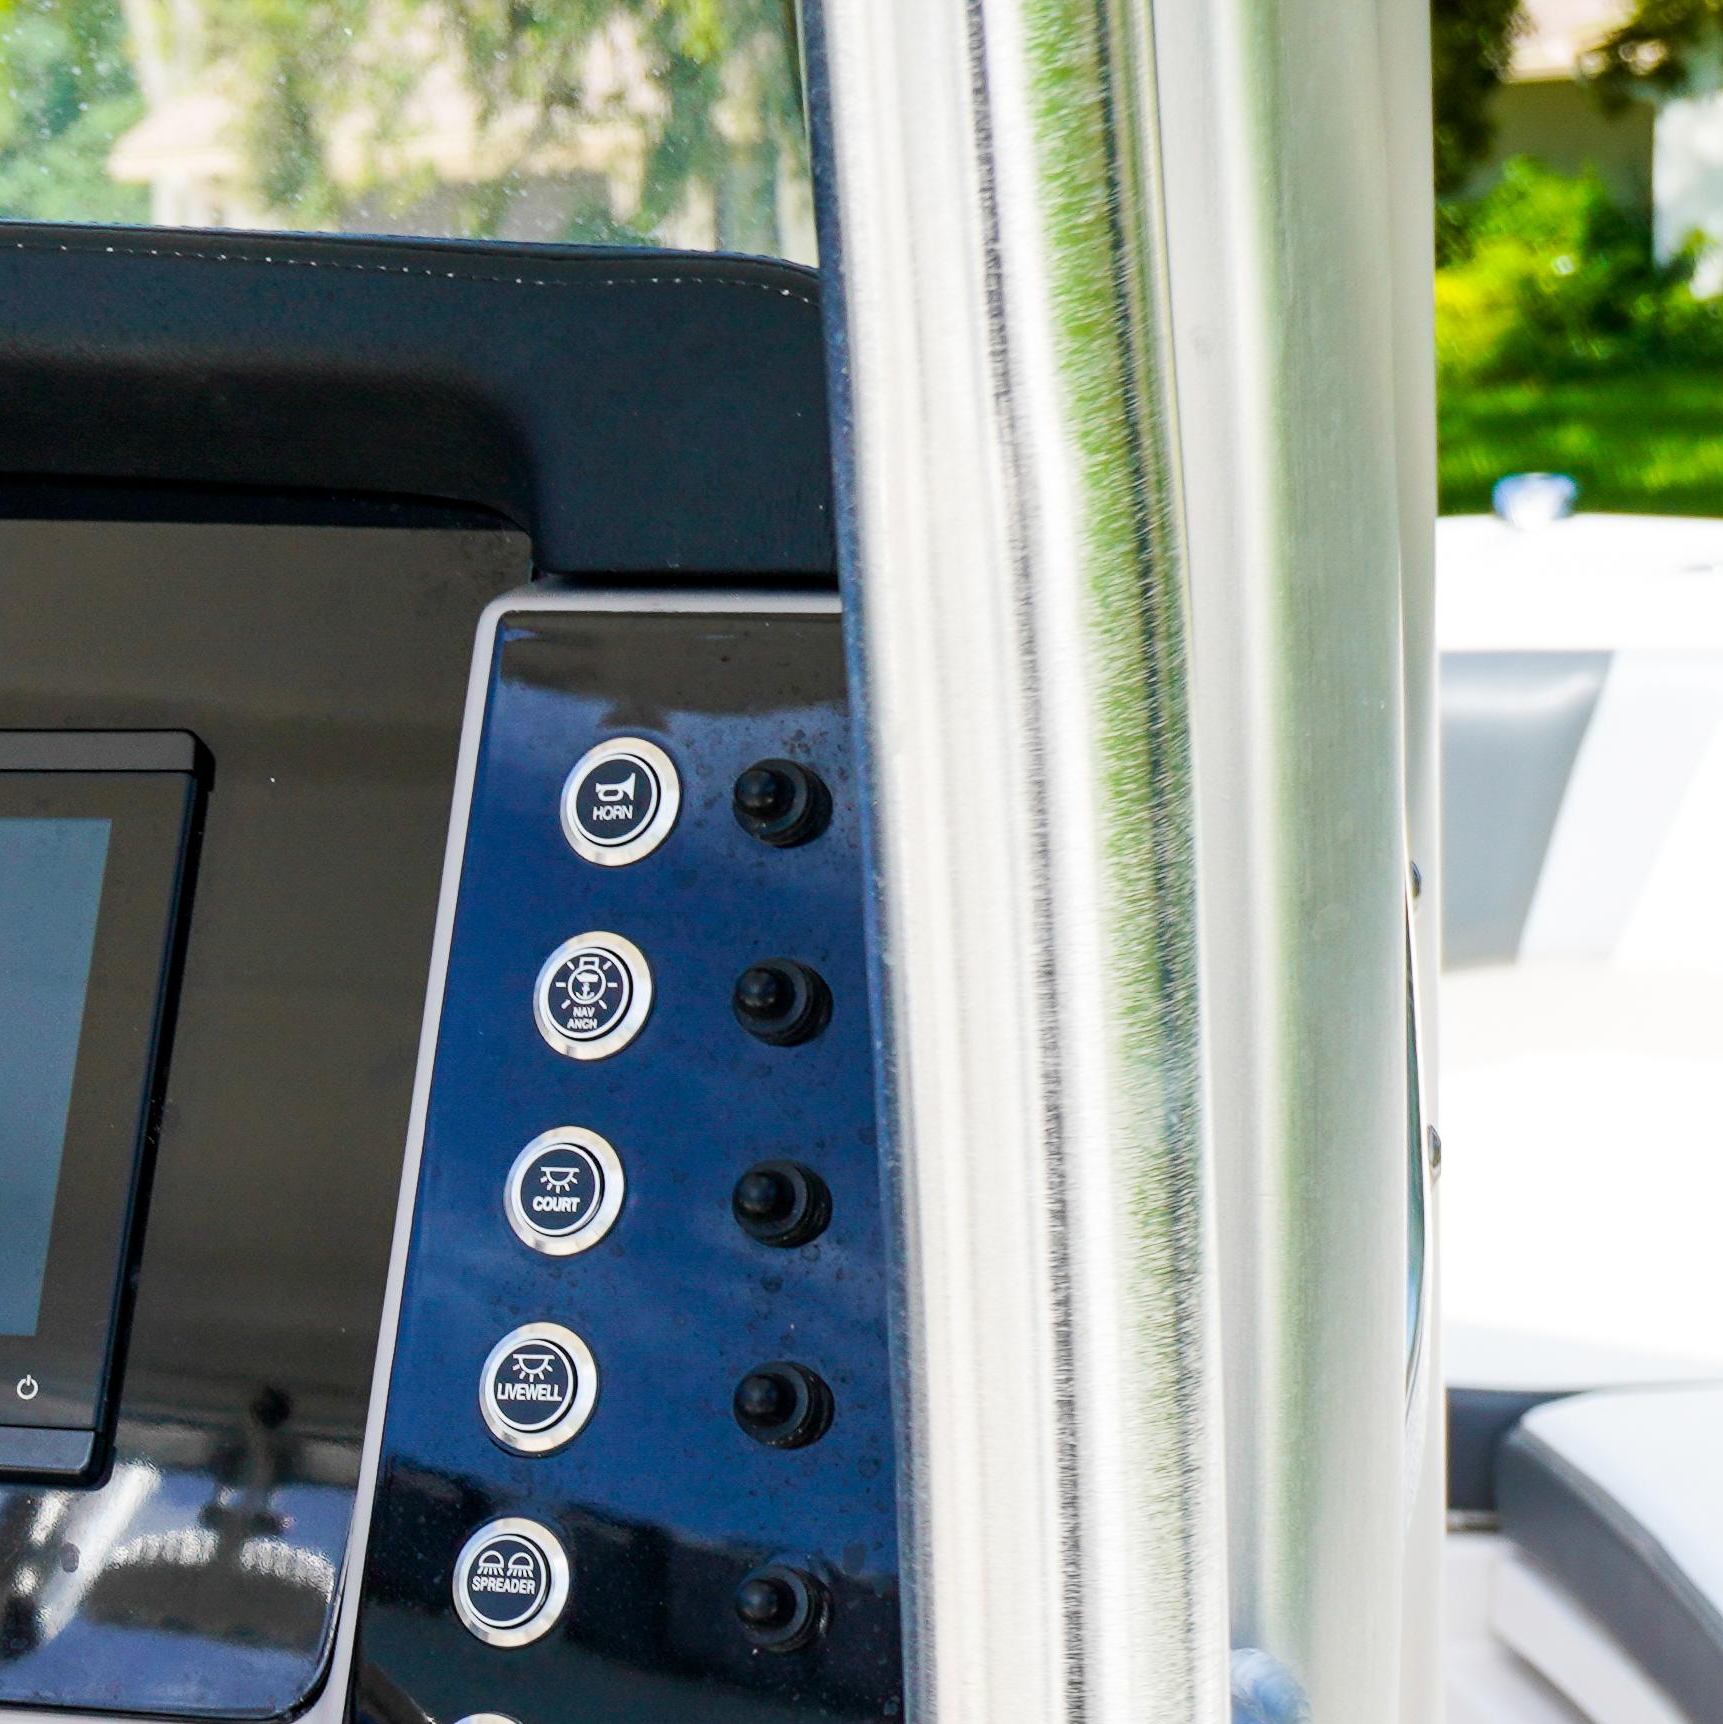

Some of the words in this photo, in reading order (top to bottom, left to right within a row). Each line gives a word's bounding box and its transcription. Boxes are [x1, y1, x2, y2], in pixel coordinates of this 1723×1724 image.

[592, 805, 633, 821] HORN
[573, 1006, 595, 1018] NAV
[567, 1018, 598, 1030] ANCH
[531, 1195, 581, 1213] COURT
[496, 1381, 563, 1403] LIVEWELL
[471, 1574, 536, 1595] SPREADER
